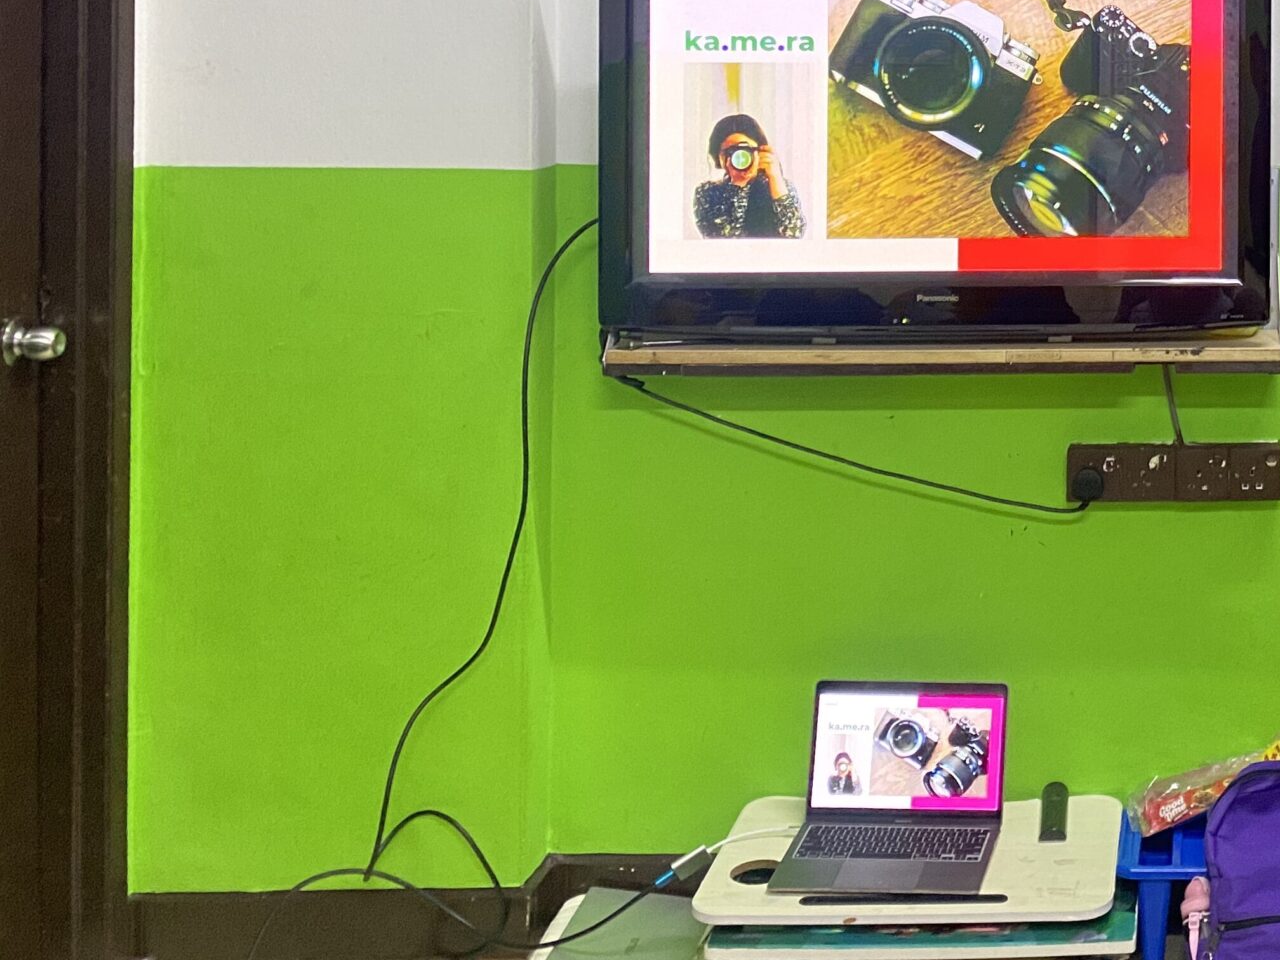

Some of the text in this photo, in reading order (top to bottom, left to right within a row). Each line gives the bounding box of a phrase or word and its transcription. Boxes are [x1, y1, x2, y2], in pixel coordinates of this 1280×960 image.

[685, 30, 815, 52] ka.me.ra
[916, 294, 959, 302] Panasonic
[829, 722, 870, 731] ka.me.ra
[1160, 796, 1184, 817] Good
